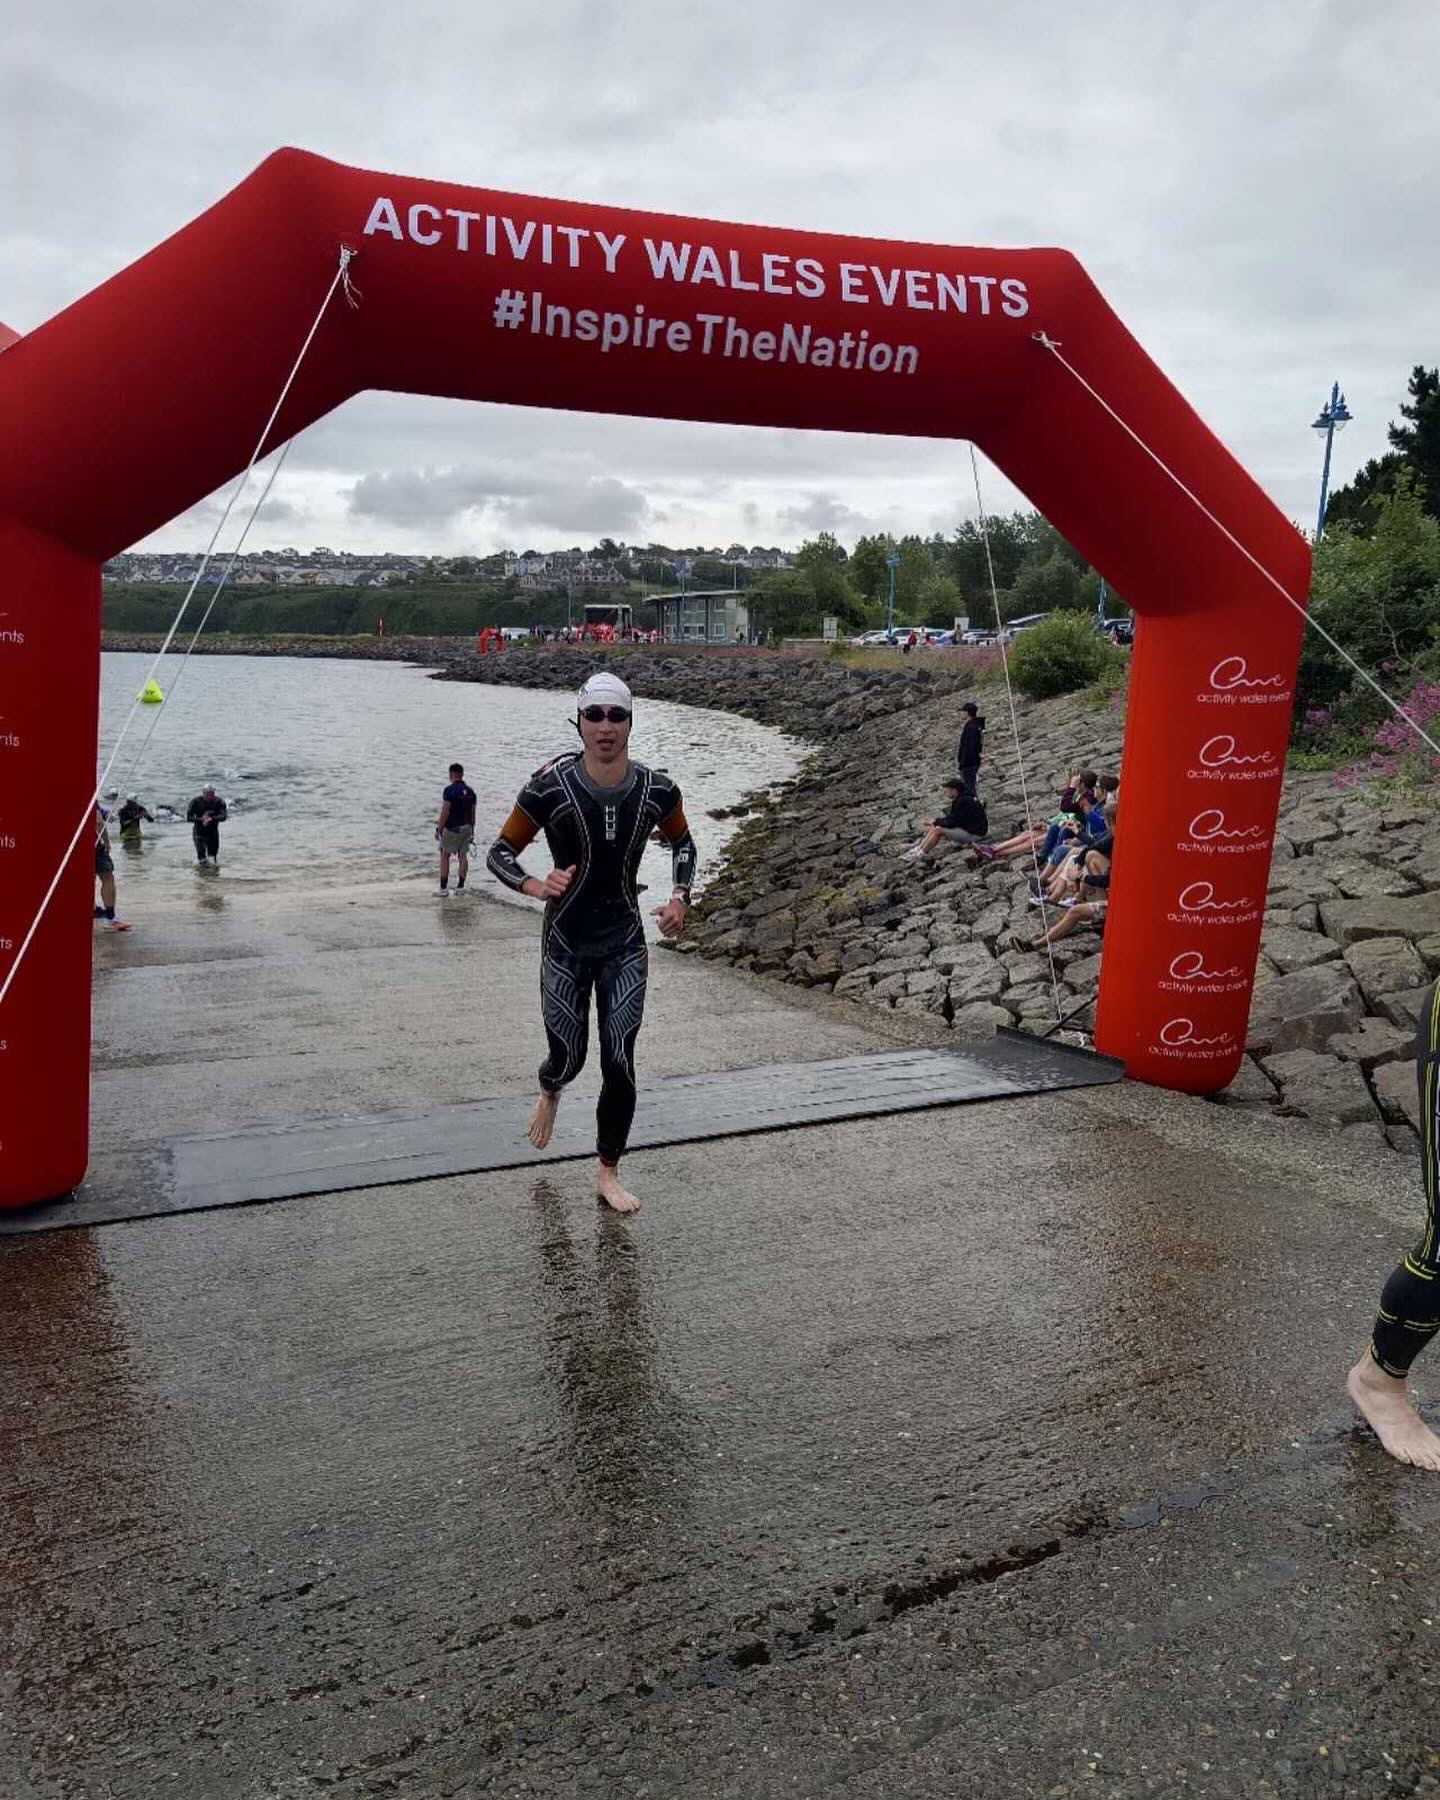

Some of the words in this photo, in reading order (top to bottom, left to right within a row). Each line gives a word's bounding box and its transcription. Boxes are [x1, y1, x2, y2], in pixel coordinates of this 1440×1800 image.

[362, 197, 628, 274] ACTIVITY
[643, 238, 826, 299] WALES
[839, 262, 1030, 319] EVENTS
[492, 288, 920, 375] #InspireTheNation
[1197, 692, 1238, 705] activity
[1187, 768, 1227, 781] activity
[605, 805, 616, 840] HUUB
